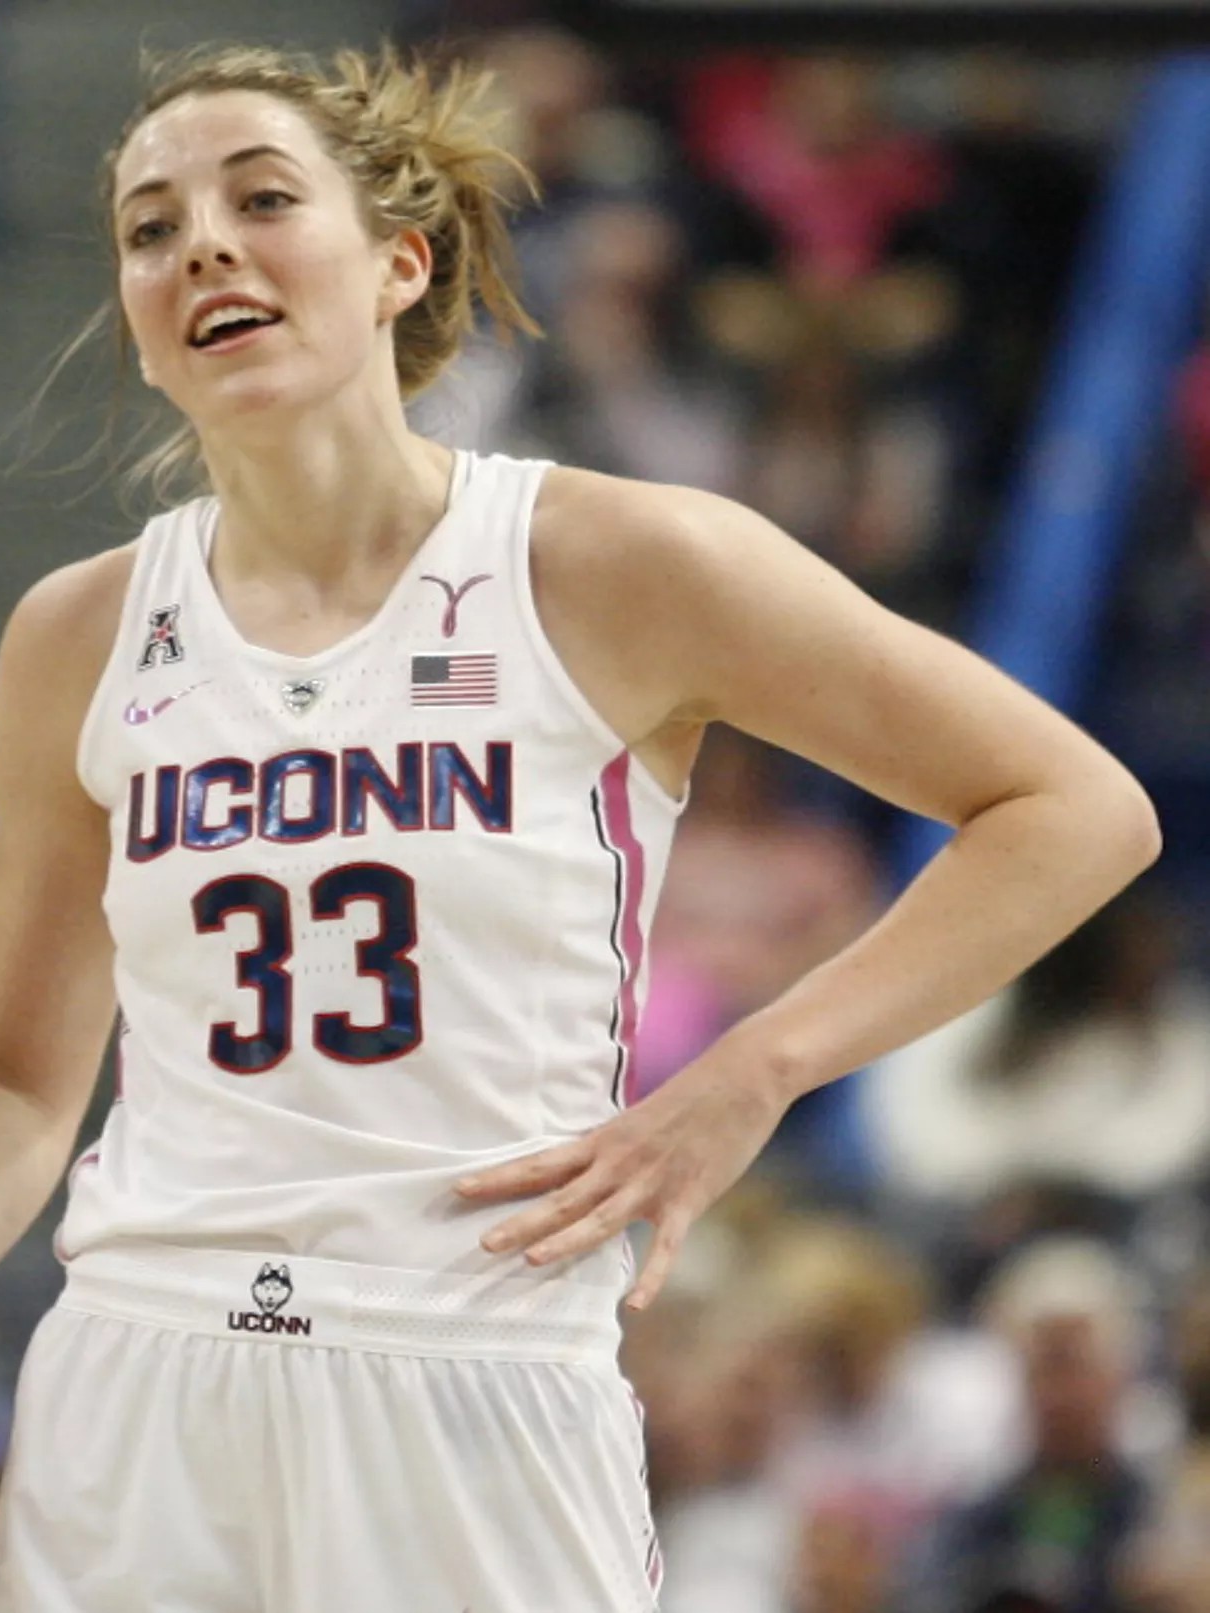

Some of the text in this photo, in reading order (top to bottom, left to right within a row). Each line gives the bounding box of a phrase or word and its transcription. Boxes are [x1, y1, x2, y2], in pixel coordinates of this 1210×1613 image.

[126, 741, 512, 863] UCONN
[191, 861, 423, 1075] 33
[228, 1310, 311, 1335] UCONN
